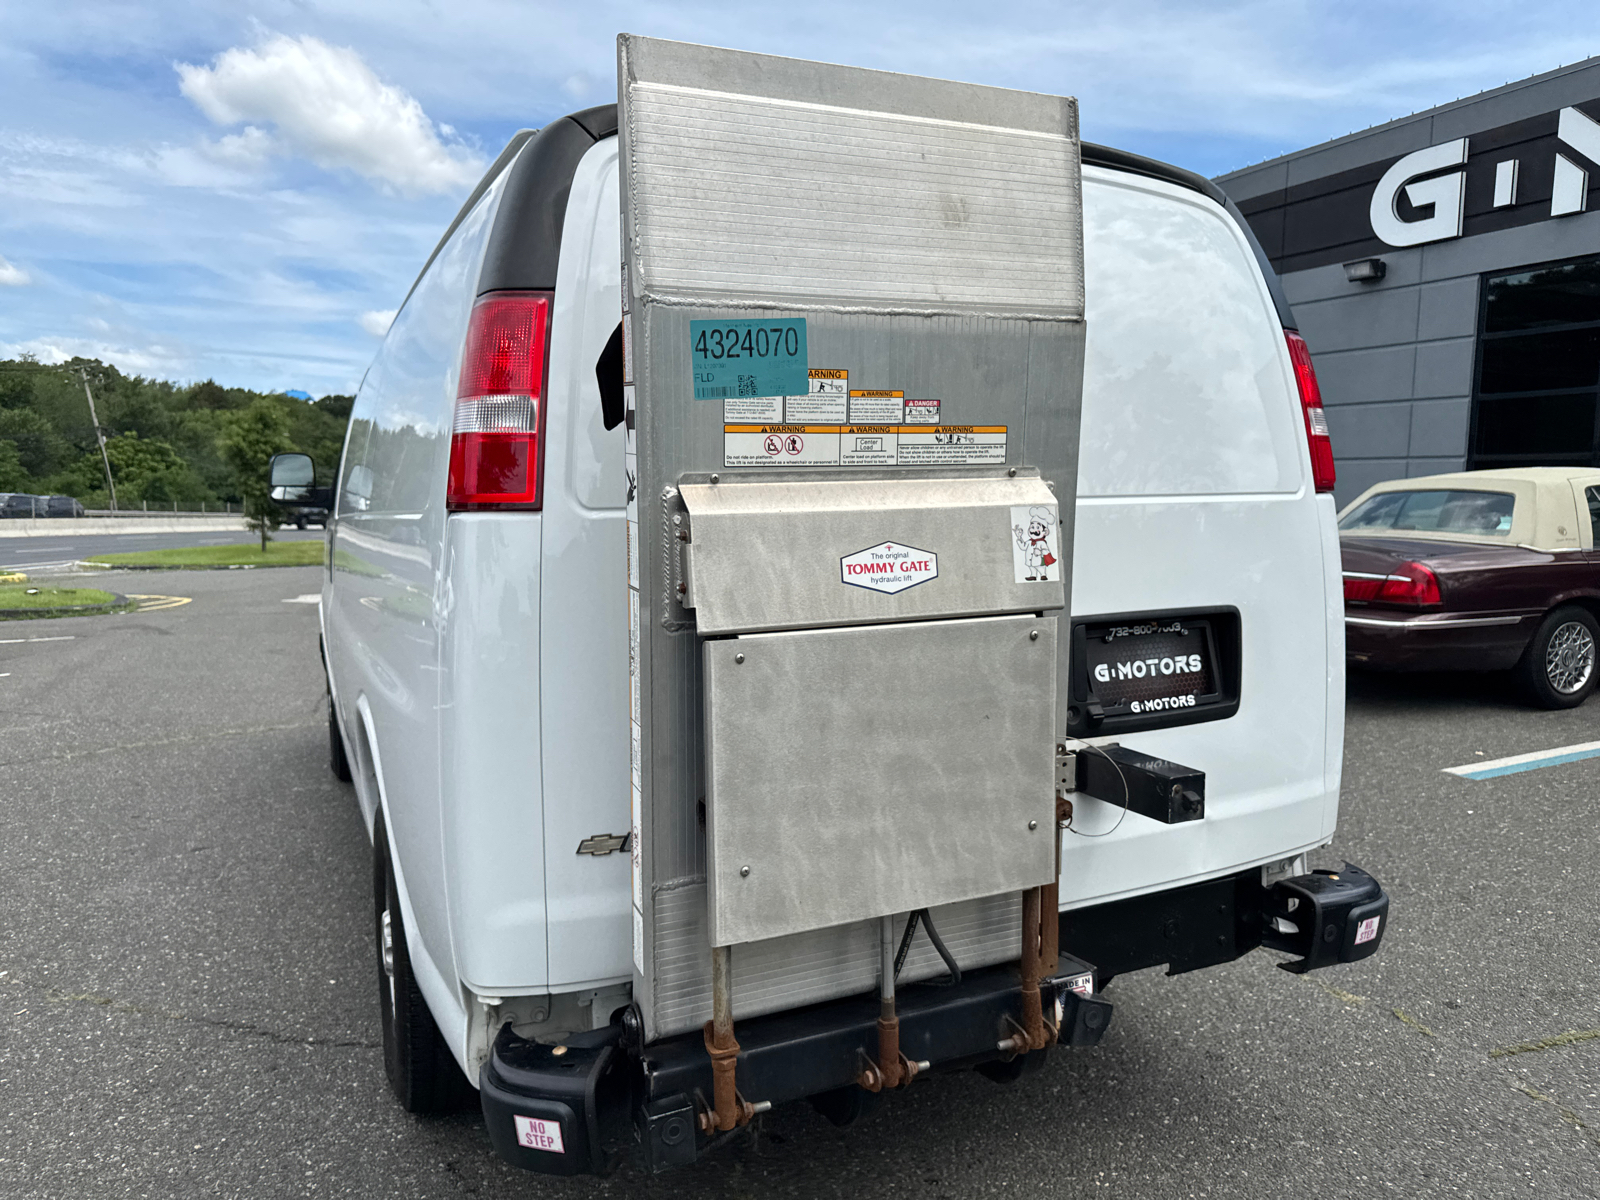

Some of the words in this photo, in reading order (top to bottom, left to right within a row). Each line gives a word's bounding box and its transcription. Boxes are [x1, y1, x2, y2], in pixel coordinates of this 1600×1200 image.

[695, 327, 798, 359] 4324070
[694, 373, 714, 382] FLD
[808, 370, 842, 379] ARNING
[885, 552, 909, 560] original
[846, 562, 895, 575] TOMMY
[900, 560, 930, 572] GATE
[870, 576, 902, 584] hydraulic
[1365, 920, 1374, 930] NO
[1359, 929, 1375, 940] STEP
[529, 1120, 545, 1134] NO
[526, 1132, 554, 1148] STEP
